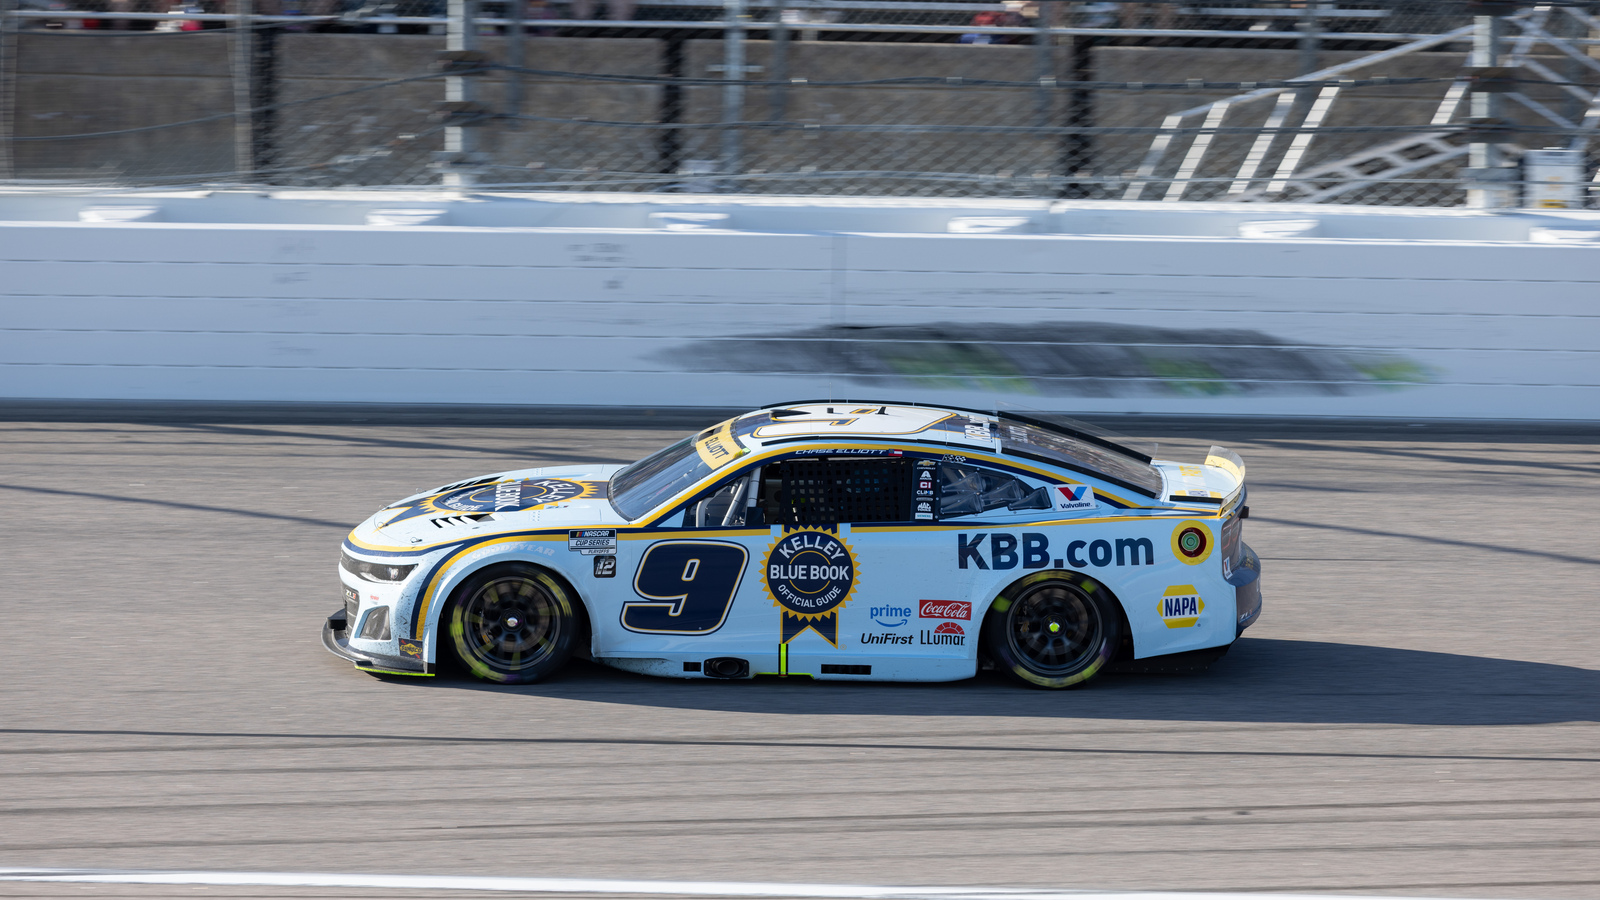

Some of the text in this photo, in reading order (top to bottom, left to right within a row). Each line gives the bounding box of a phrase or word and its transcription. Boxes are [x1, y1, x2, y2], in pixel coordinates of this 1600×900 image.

[471, 543, 556, 559] GOODYEAR
[778, 534, 845, 560] KELLEY
[957, 532, 1155, 571] KBB.com
[770, 564, 850, 581] BLUE BOOK
[619, 538, 750, 637] 9
[777, 584, 842, 608] OFFICIAL GUIDE
[870, 604, 912, 620] prime
[920, 601, 971, 618] Coca-Cola
[1164, 596, 1198, 617] NAPA
[860, 632, 914, 645] UniFirst
[920, 629, 966, 646] LLumar
